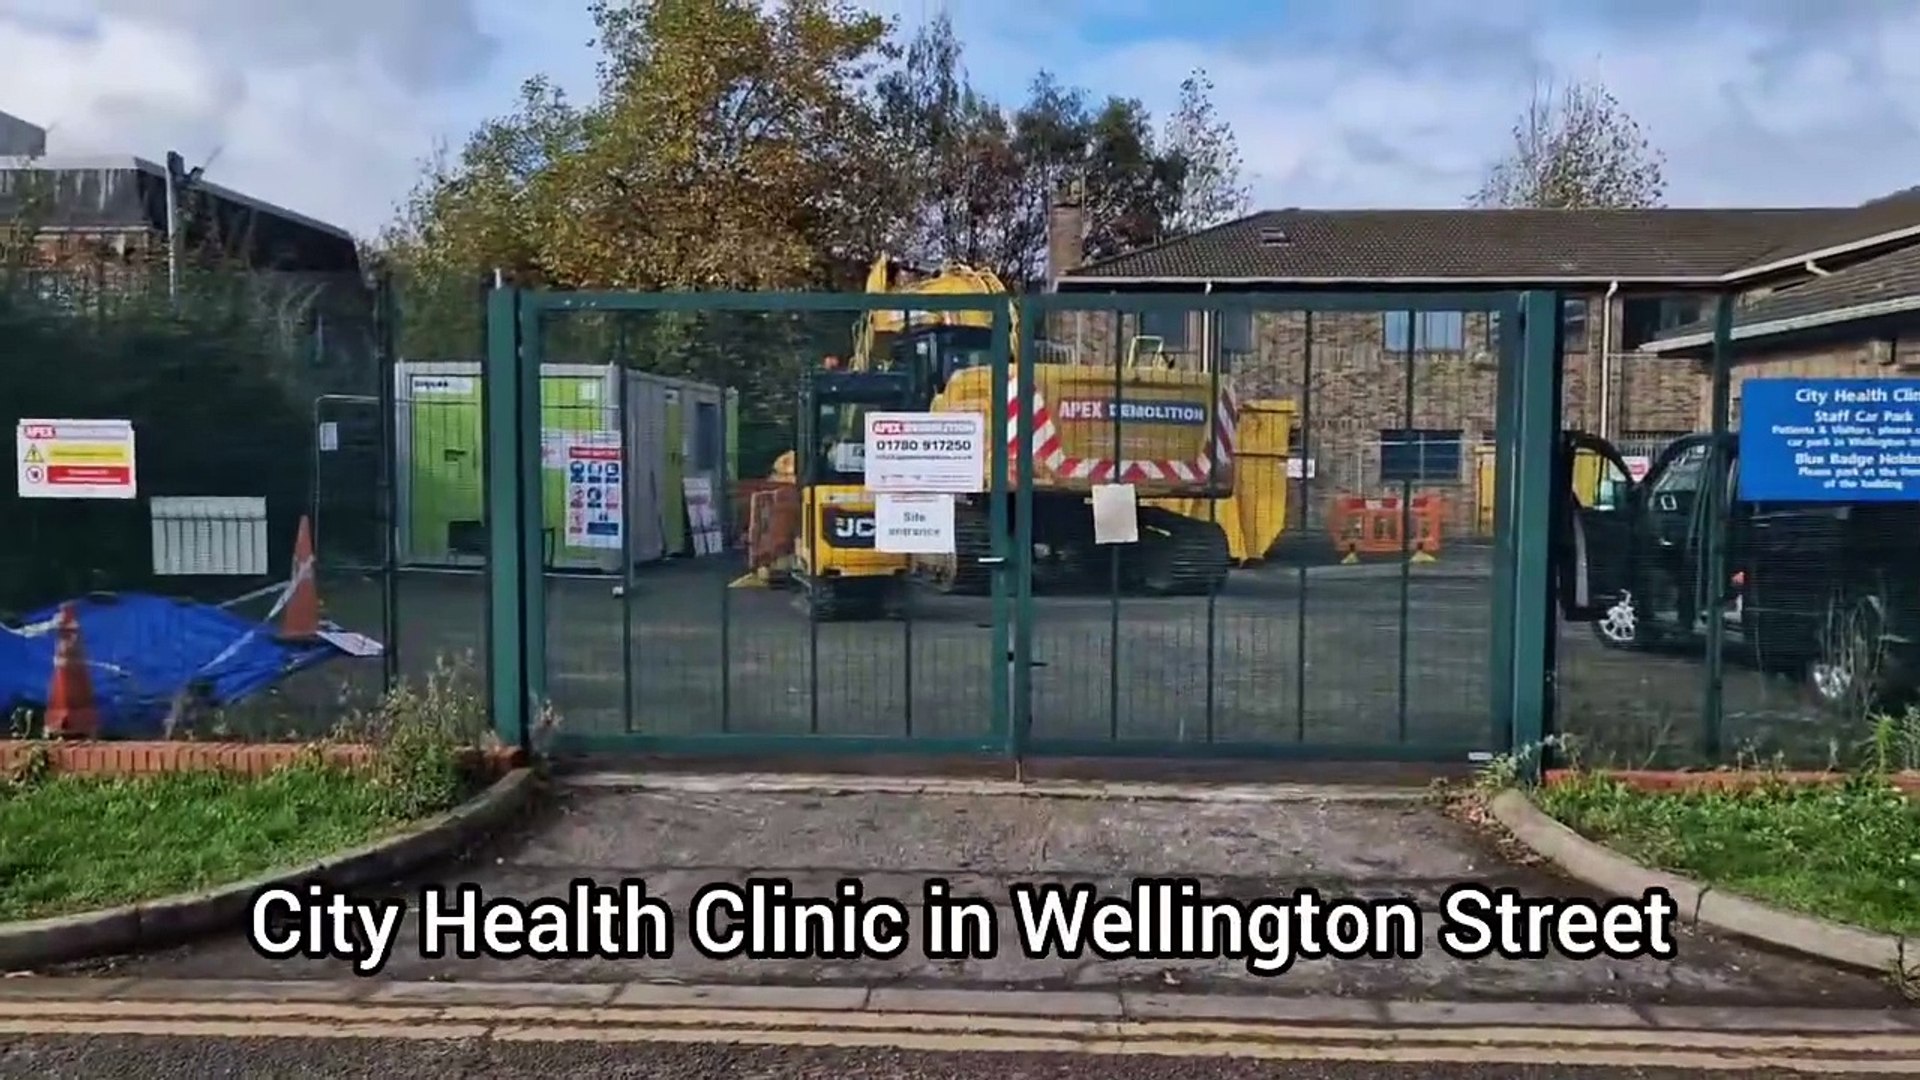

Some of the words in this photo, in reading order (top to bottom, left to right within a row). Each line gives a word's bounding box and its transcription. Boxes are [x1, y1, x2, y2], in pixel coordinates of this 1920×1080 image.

[1795, 388, 1828, 406] City
[1834, 388, 1888, 403] Health
[1059, 400, 1102, 418] APEX
[1109, 403, 1204, 421] DEMOLITION
[1814, 409, 1850, 422] Staff
[1855, 410, 1878, 422] Car
[1883, 409, 1913, 422] Park
[874, 421, 902, 434] APEX
[876, 440, 918, 451] 01780
[922, 440, 972, 451] 917250
[1795, 453, 1824, 465] Blue
[1830, 453, 1875, 467] Badge
[903, 511, 926, 522] Site
[835, 517, 876, 537] JC
